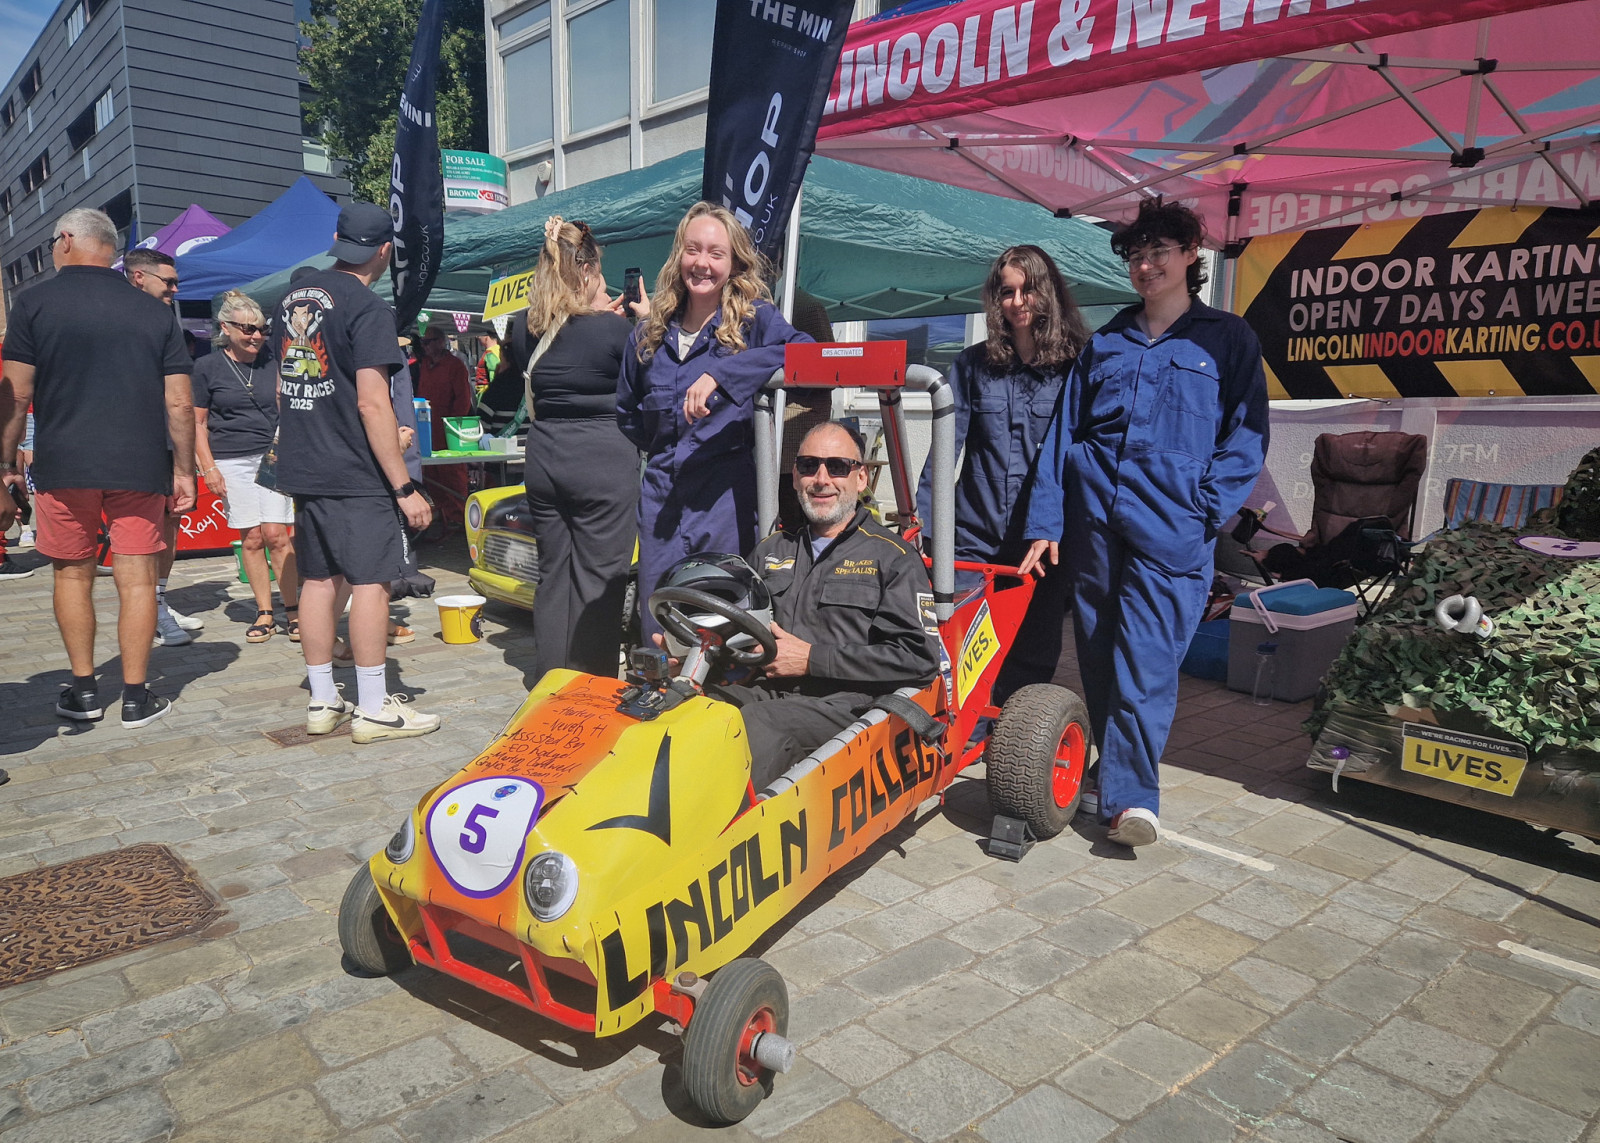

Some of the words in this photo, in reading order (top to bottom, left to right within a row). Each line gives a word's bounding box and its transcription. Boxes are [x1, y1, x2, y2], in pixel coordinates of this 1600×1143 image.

[750, 0, 797, 28] THE
[1048, 0, 1096, 67] &
[445, 155, 464, 165] FOR
[465, 157, 486, 167] SALE
[1290, 256, 1437, 298] INDOOR
[1450, 244, 1600, 285] KARTIN
[1289, 298, 1362, 332] OPEN
[1373, 296, 1390, 326] 7
[1400, 289, 1486, 324] DAYS
[1496, 287, 1520, 318] A
[834, 348, 863, 356] ACTIVATED
[290, 398, 314, 410] 2025
[304, 378, 336, 398] RACES
[401, 532, 410, 565] ARMOUR
[1421, 730, 1444, 740] WE'RE
[1444, 734, 1472, 745] RACING
[1473, 740, 1488, 749] FOR
[1489, 743, 1512, 753] LIVES.
[1415, 744, 1509, 784] LIVES.
[459, 803, 500, 854] 5
[601, 808, 808, 1012] LINCOLN
